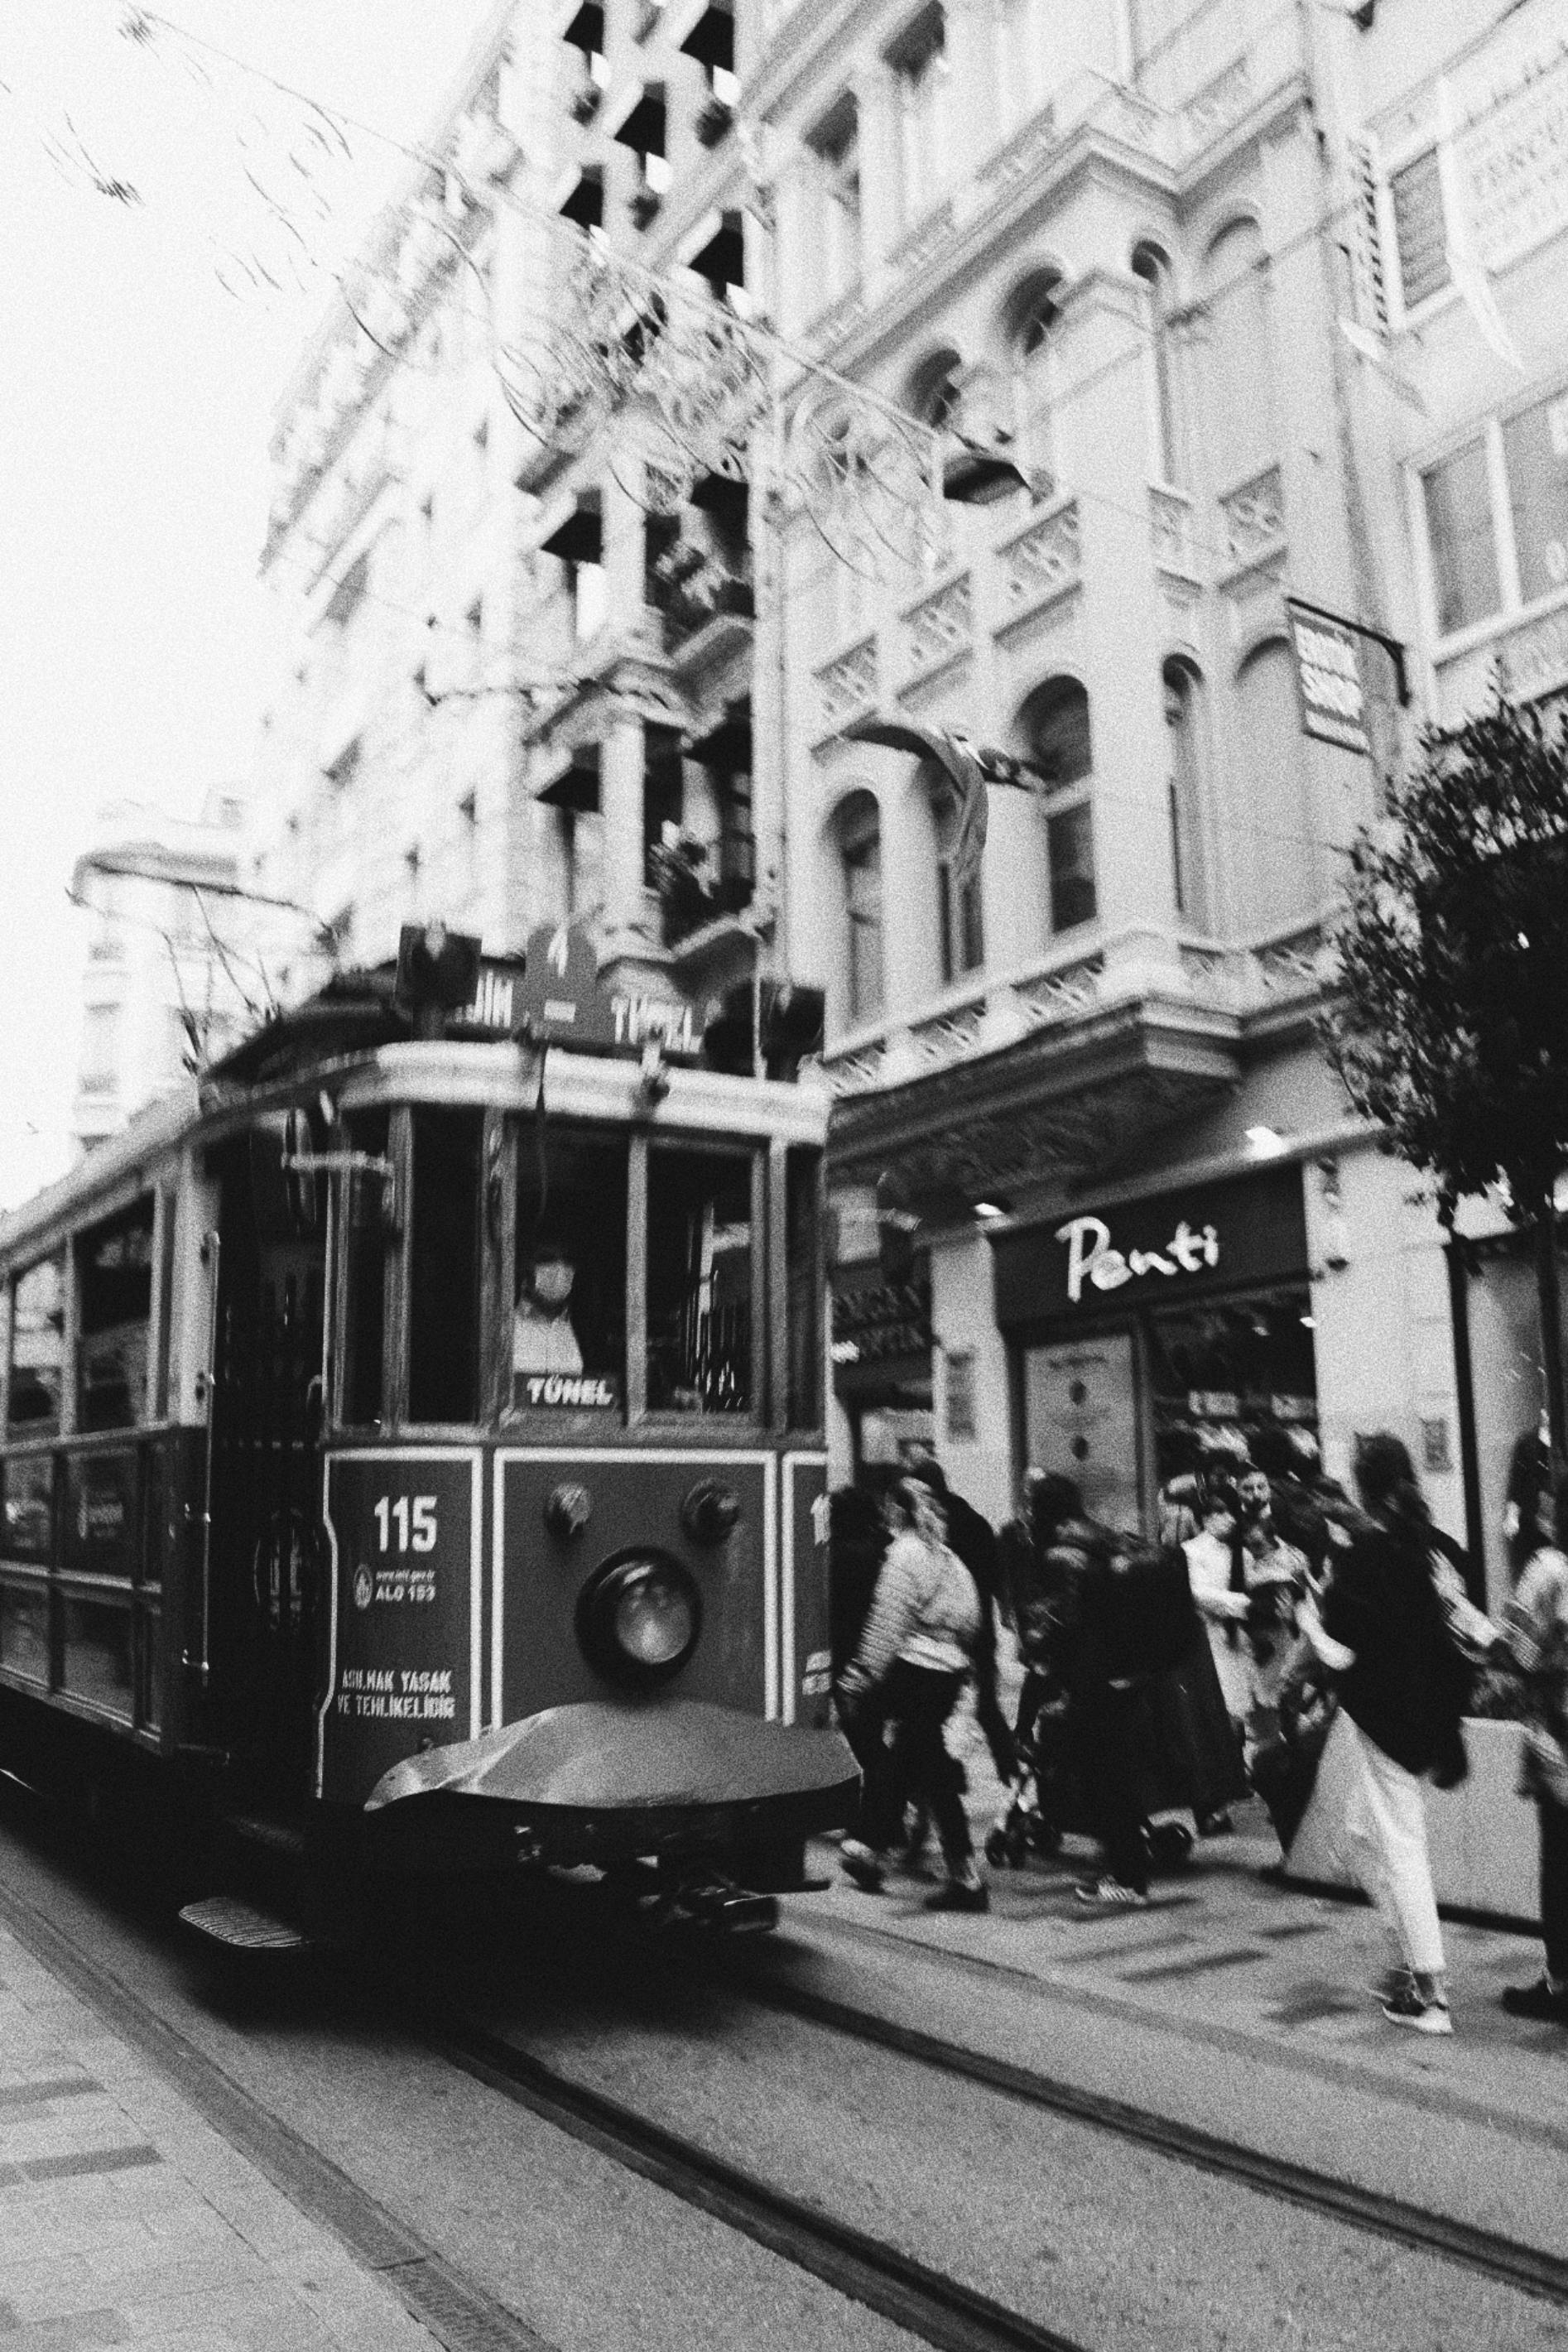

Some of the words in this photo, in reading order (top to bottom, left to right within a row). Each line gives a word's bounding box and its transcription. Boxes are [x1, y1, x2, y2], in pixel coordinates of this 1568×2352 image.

[527, 1374, 613, 1405] TÜNEL
[374, 1495, 437, 1552] 115
[401, 1670, 452, 1693] YASAK
[337, 1694, 351, 1715] VE
